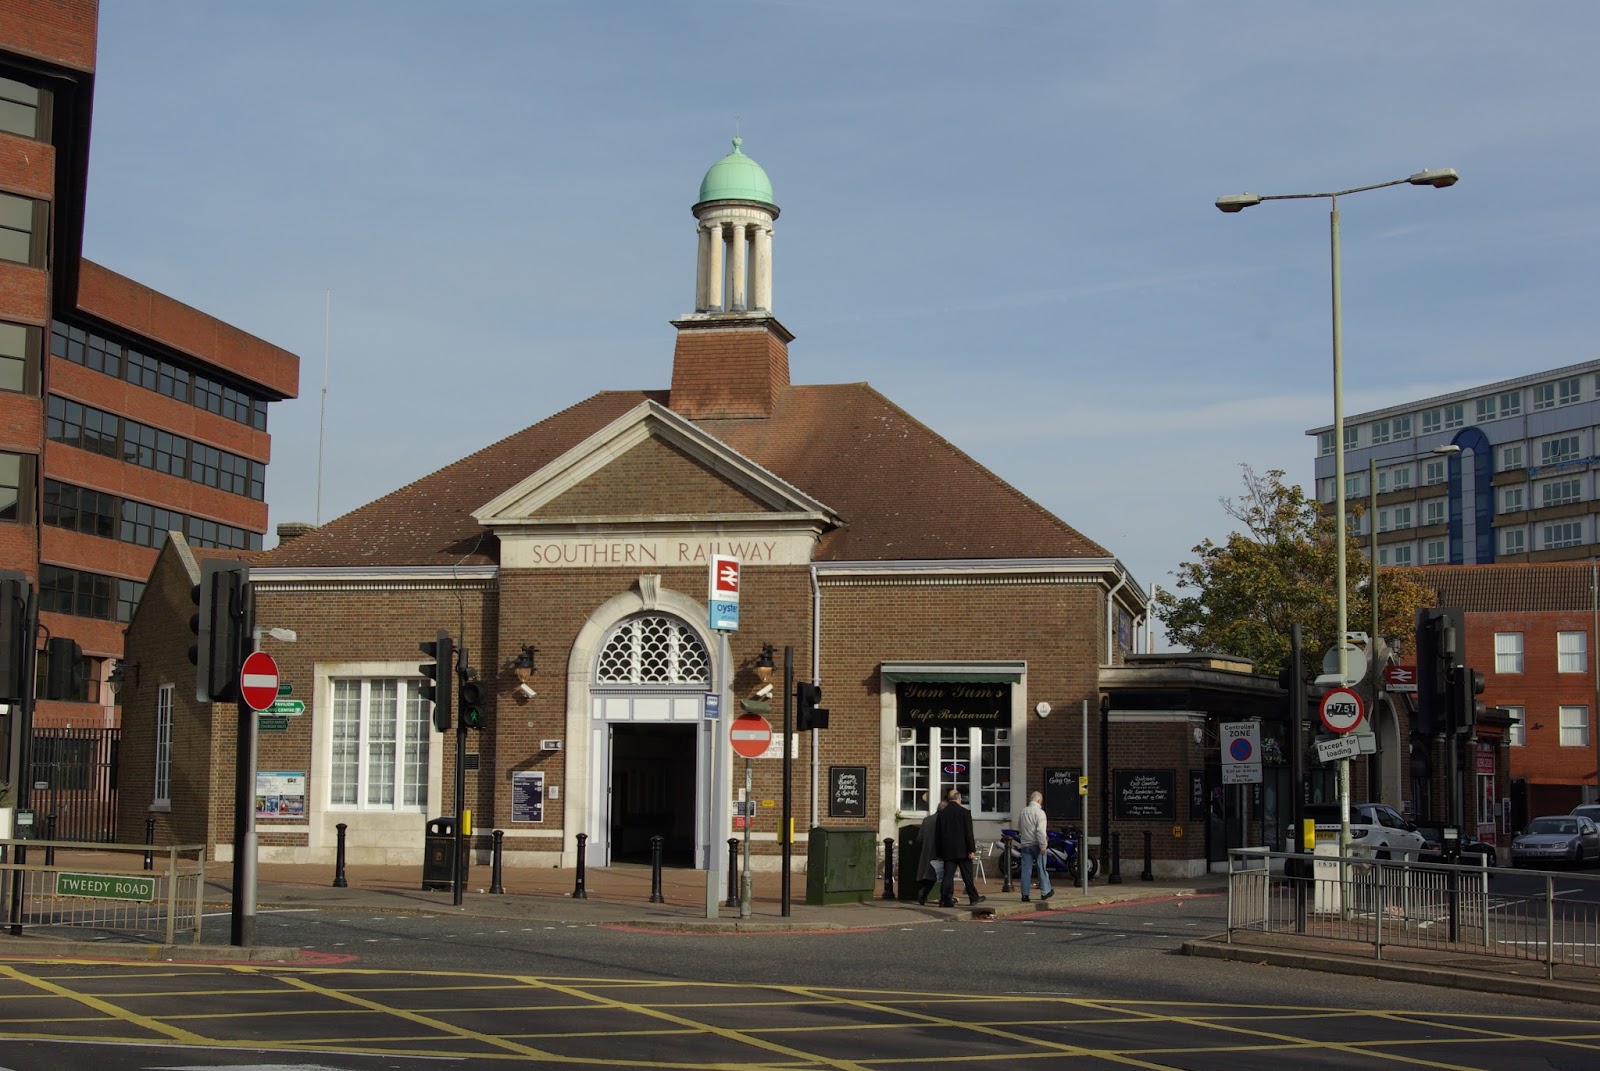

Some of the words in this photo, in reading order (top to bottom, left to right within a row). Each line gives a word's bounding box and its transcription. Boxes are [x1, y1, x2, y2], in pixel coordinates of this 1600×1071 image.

[532, 542, 657, 564] SOUTHERN
[717, 603, 738, 614] oyster
[1336, 703, 1356, 713] 7.5T
[909, 709, 935, 722] Cafe
[937, 709, 1000, 720] Restaurant
[1319, 741, 1343, 751] Except
[1326, 748, 1352, 757] loading
[62, 879, 110, 892] TWEEDY
[115, 882, 149, 895] ROAD
